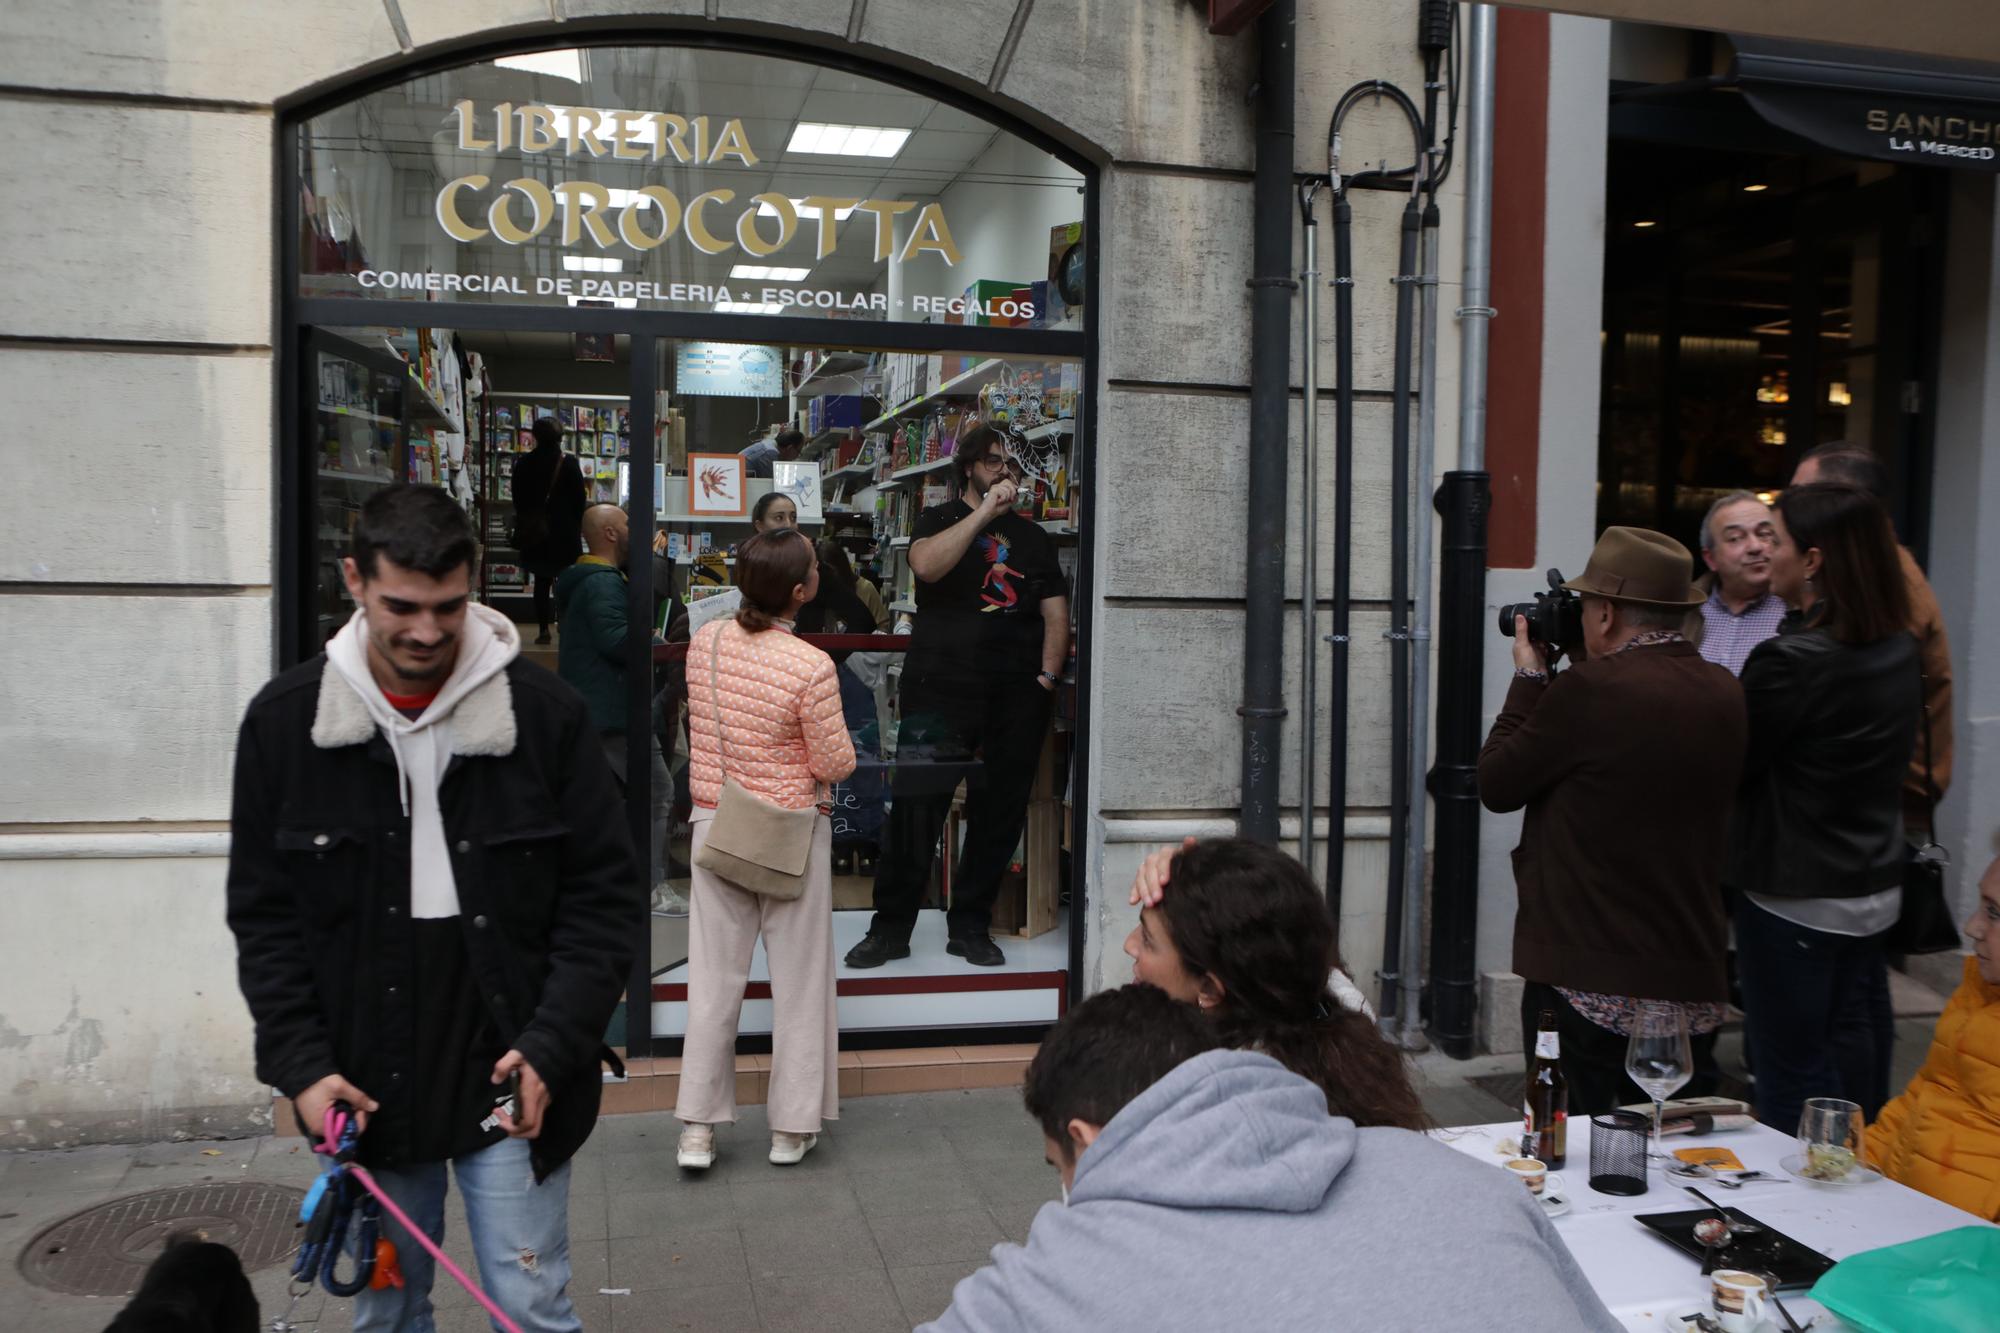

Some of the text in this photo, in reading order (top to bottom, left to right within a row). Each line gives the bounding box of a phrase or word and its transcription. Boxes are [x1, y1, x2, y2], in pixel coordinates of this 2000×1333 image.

[455, 99, 759, 168] LIBRERIA
[1866, 109, 2000, 145] SANCH
[1889, 137, 1995, 160] LA MERCED
[436, 174, 963, 266] COROCOTTA
[357, 268, 1037, 319] COMERCIAL DE PAPELERIA ESCOLAR REGALOS
